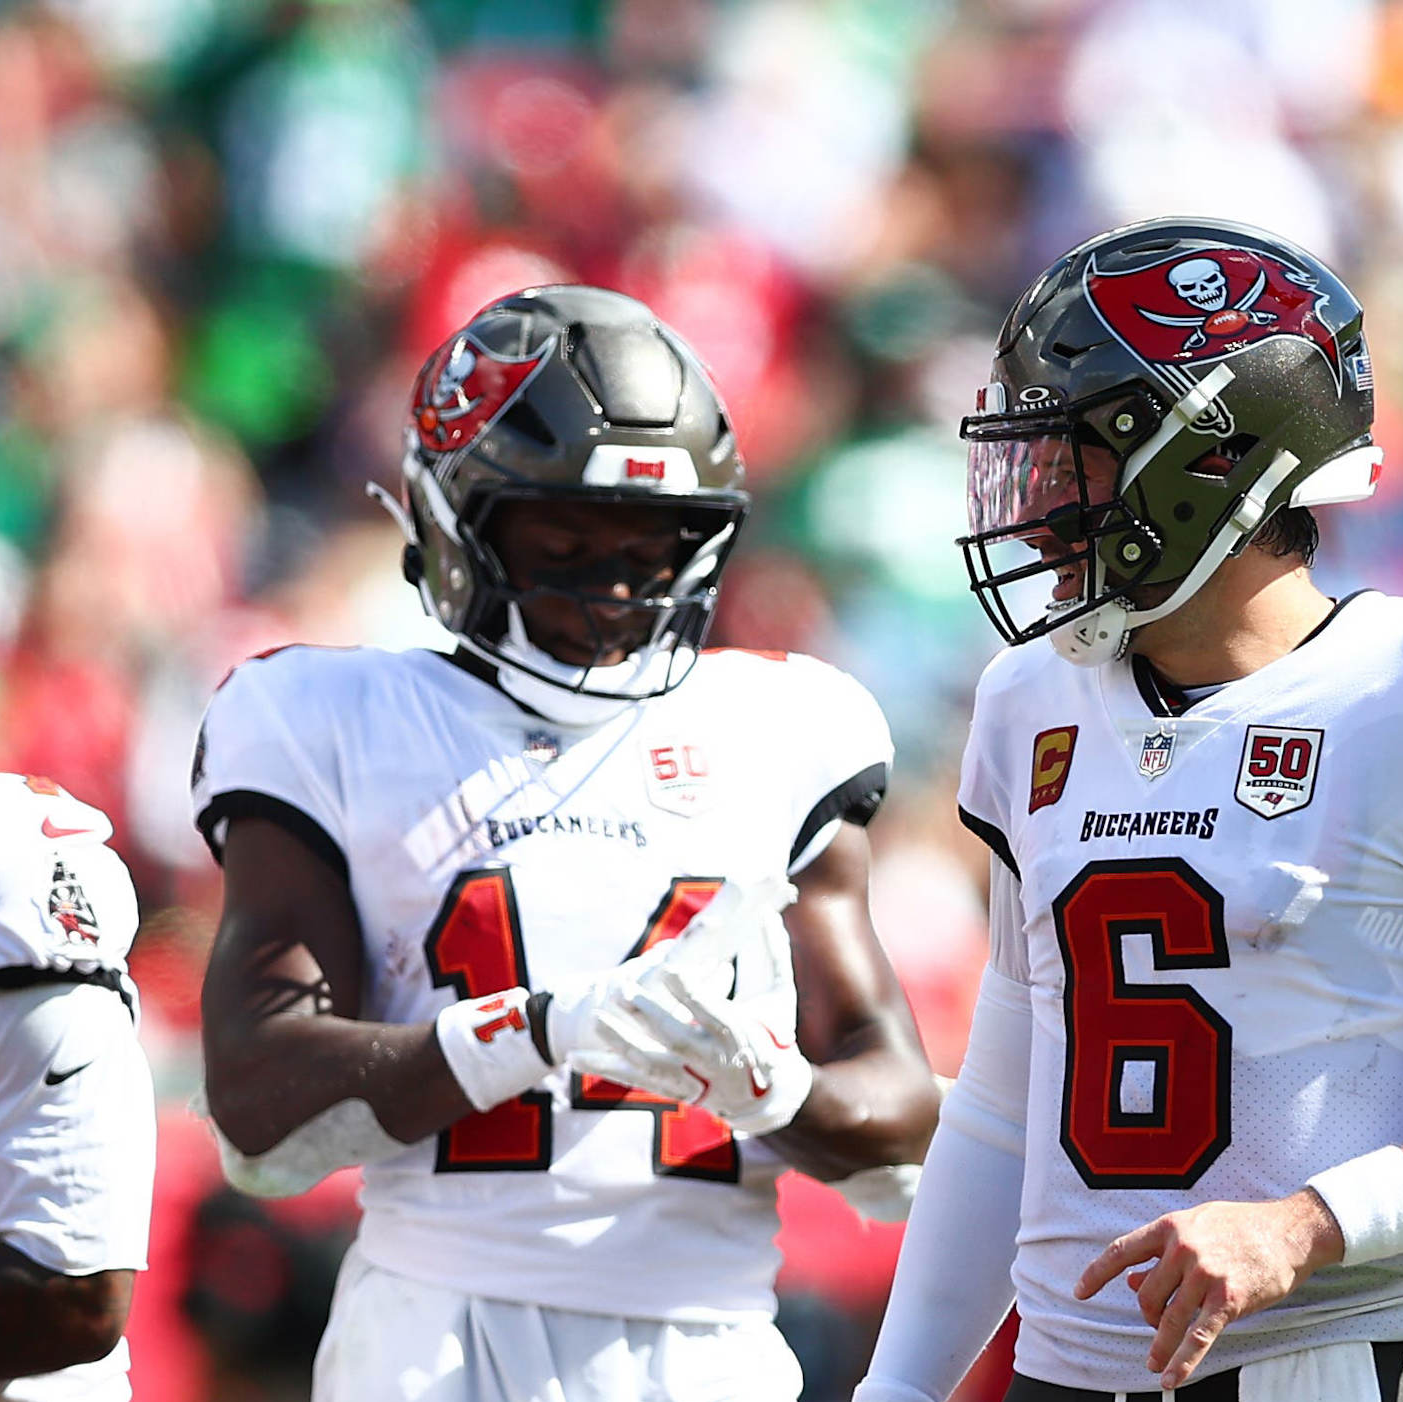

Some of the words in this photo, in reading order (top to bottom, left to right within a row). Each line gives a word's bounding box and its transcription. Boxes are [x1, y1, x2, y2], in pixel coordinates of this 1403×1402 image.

[1014, 399, 1059, 412] OAKLEY
[649, 745, 711, 781] 50
[1032, 731, 1071, 788] C
[1142, 750, 1167, 769] NFL
[1248, 735, 1313, 780] 50
[1254, 781, 1296, 789] SEASONS
[1079, 807, 1220, 843] BUCCANEERS
[1052, 856, 1233, 1190] 6
